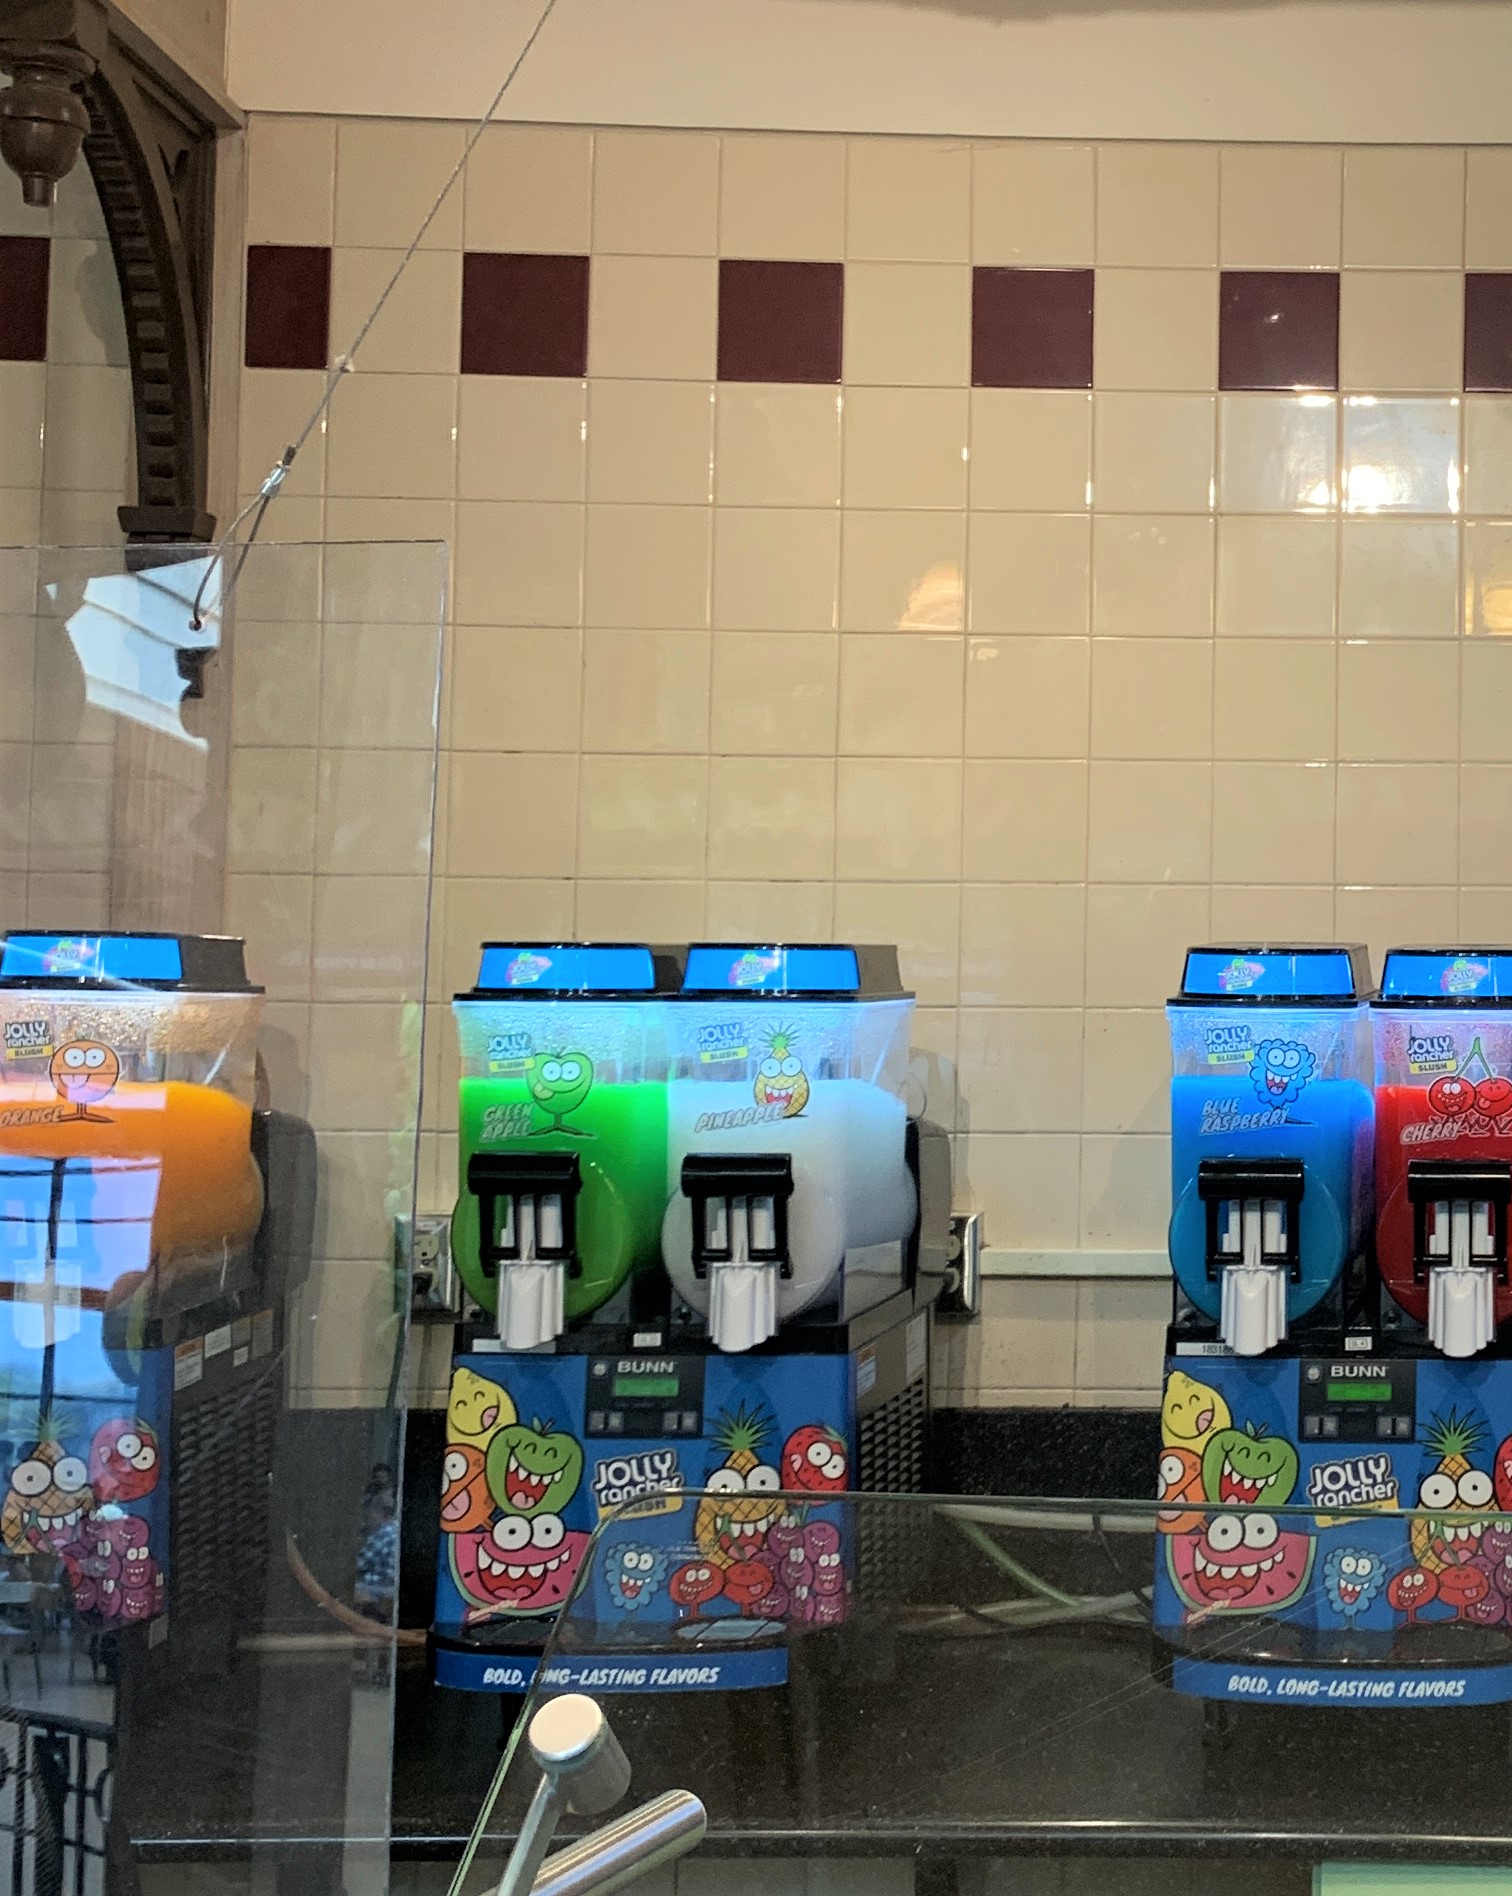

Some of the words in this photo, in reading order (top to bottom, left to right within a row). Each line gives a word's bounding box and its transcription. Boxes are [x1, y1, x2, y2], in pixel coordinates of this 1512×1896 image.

[5, 1021, 46, 1039] JOLLY
[698, 1023, 742, 1043] JOLLY
[1206, 1026, 1248, 1045] JOLLY
[1409, 1036, 1451, 1055] JOLLY
[1410, 1049, 1454, 1063] rancher
[0, 1105, 63, 1127] ORANGE
[1202, 1097, 1240, 1117] BLUE
[695, 1103, 785, 1133] PINEAPPLE
[1200, 1108, 1290, 1135] RASPBERRY
[1402, 1121, 1460, 1143] CHERRY
[617, 1361, 674, 1373] BUNN
[1331, 1365, 1387, 1377] BUNN
[595, 1452, 672, 1490] JOLLY
[1311, 1457, 1387, 1494] JOLLY
[1317, 1482, 1394, 1508] rancher
[483, 1667, 526, 1687] BOLD,
[530, 1668, 647, 1686] NG-LASTING
[650, 1667, 721, 1685] FLAVORS
[1228, 1675, 1273, 1696] BOLD,
[1276, 1678, 1394, 1698] LONG-LASTING
[1398, 1680, 1467, 1698] FLAVORS
